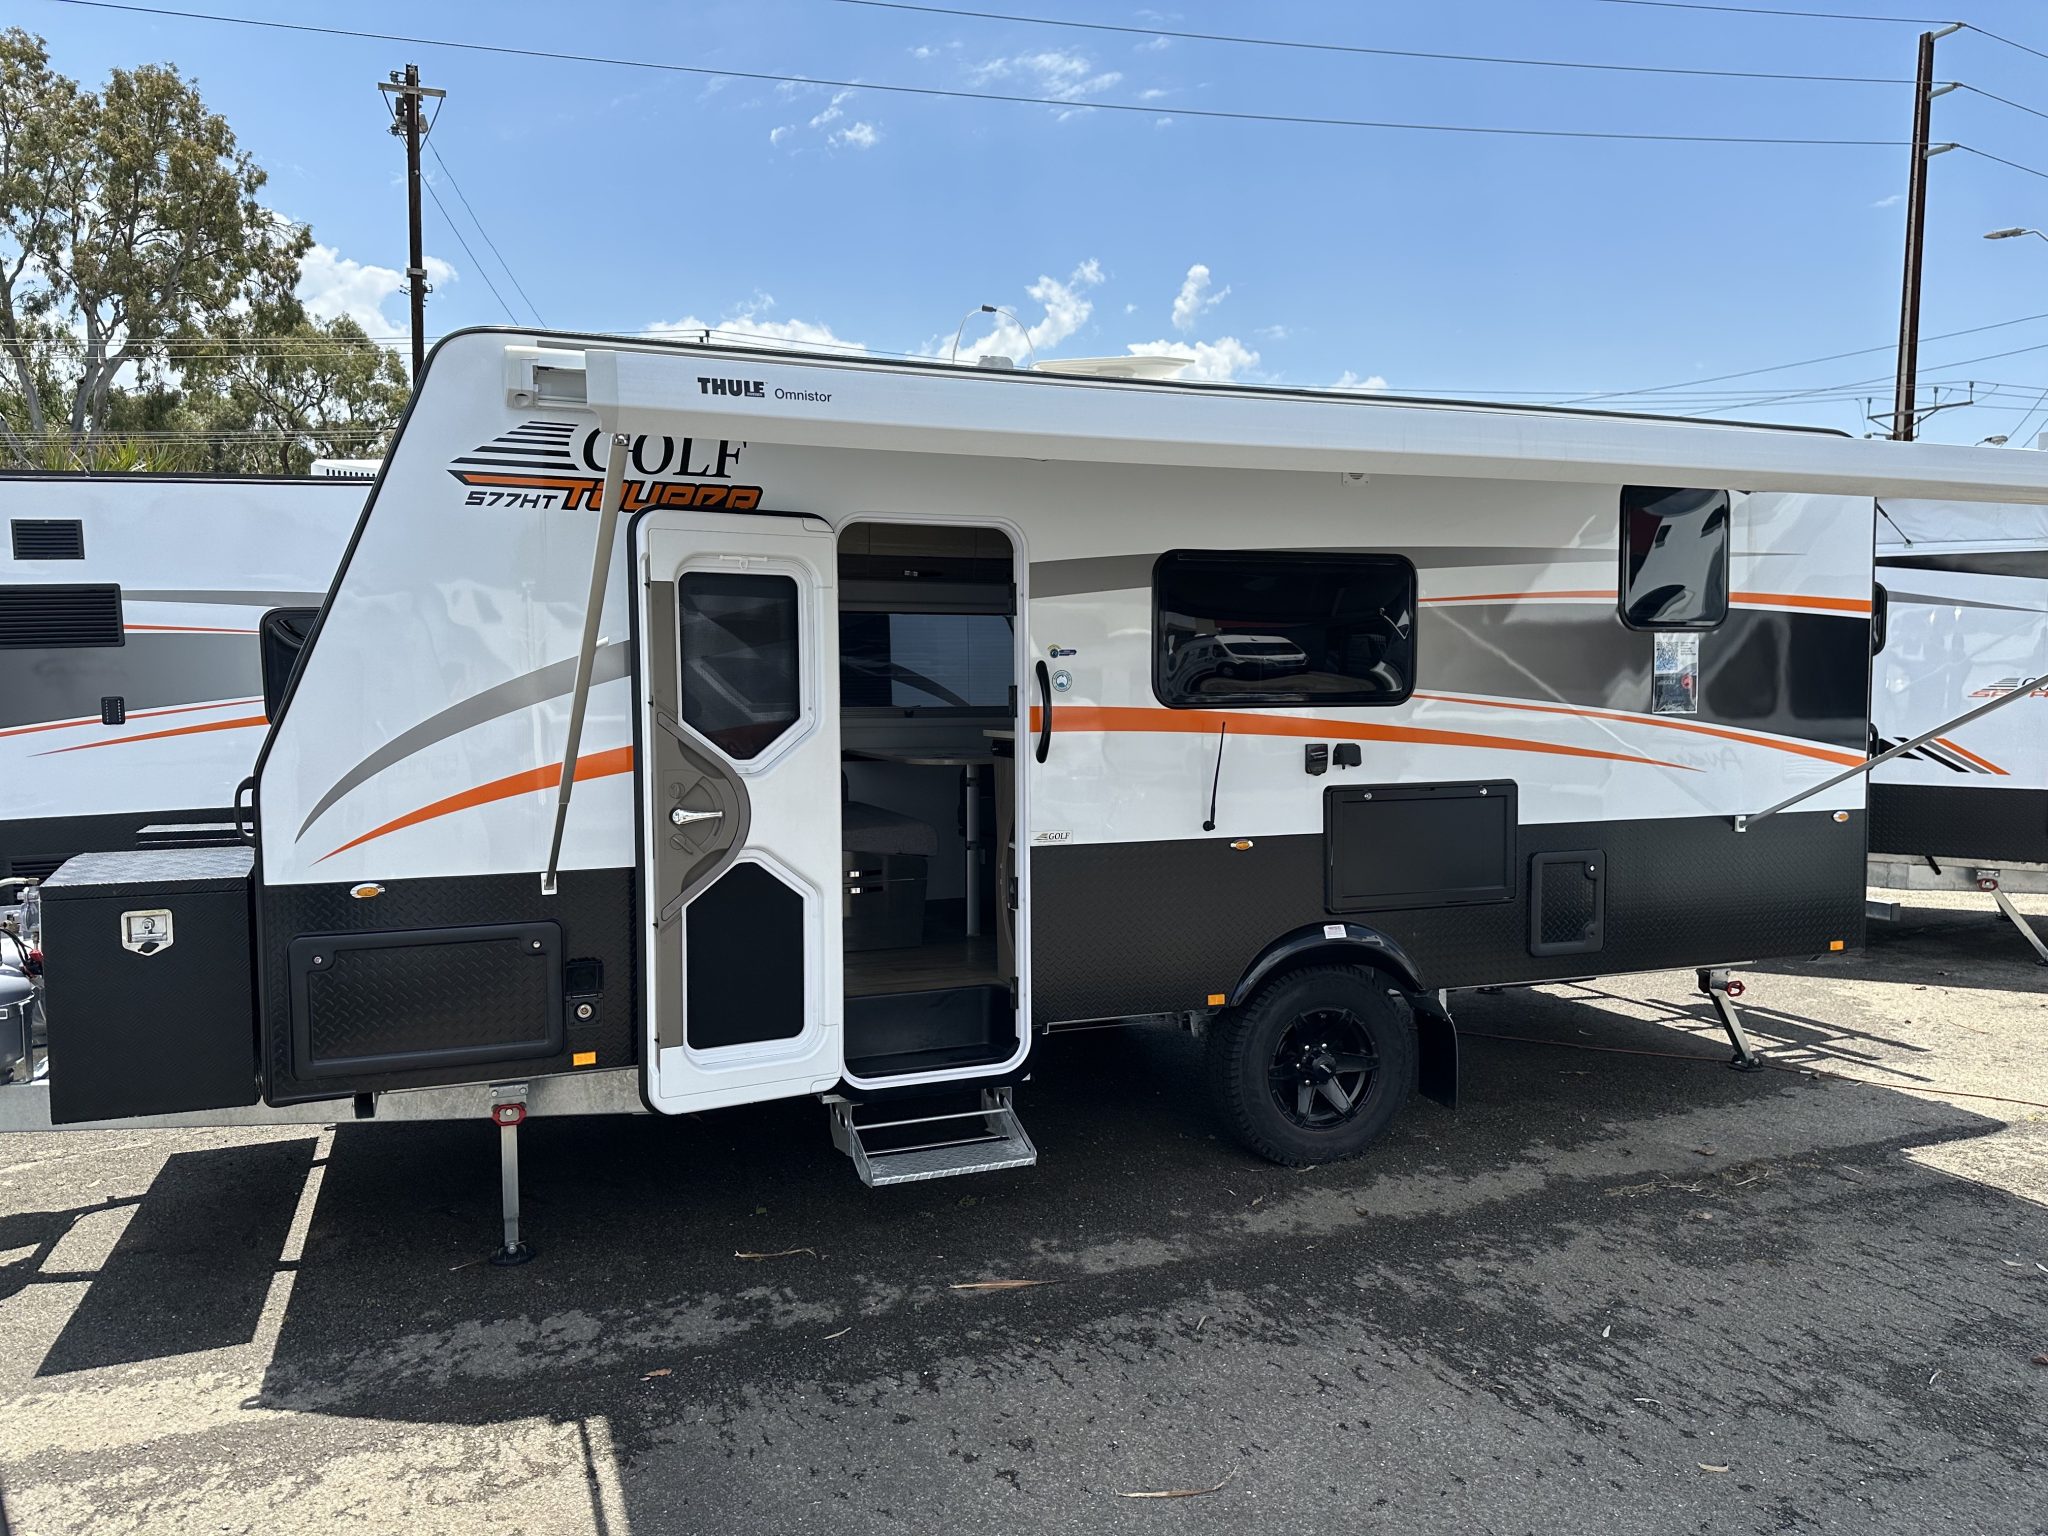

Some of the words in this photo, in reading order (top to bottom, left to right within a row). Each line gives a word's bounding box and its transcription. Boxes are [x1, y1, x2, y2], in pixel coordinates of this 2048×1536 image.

[697, 377, 765, 398] THULE
[774, 388, 832, 402] Omnistor
[1048, 832, 1071, 840] GOLF
